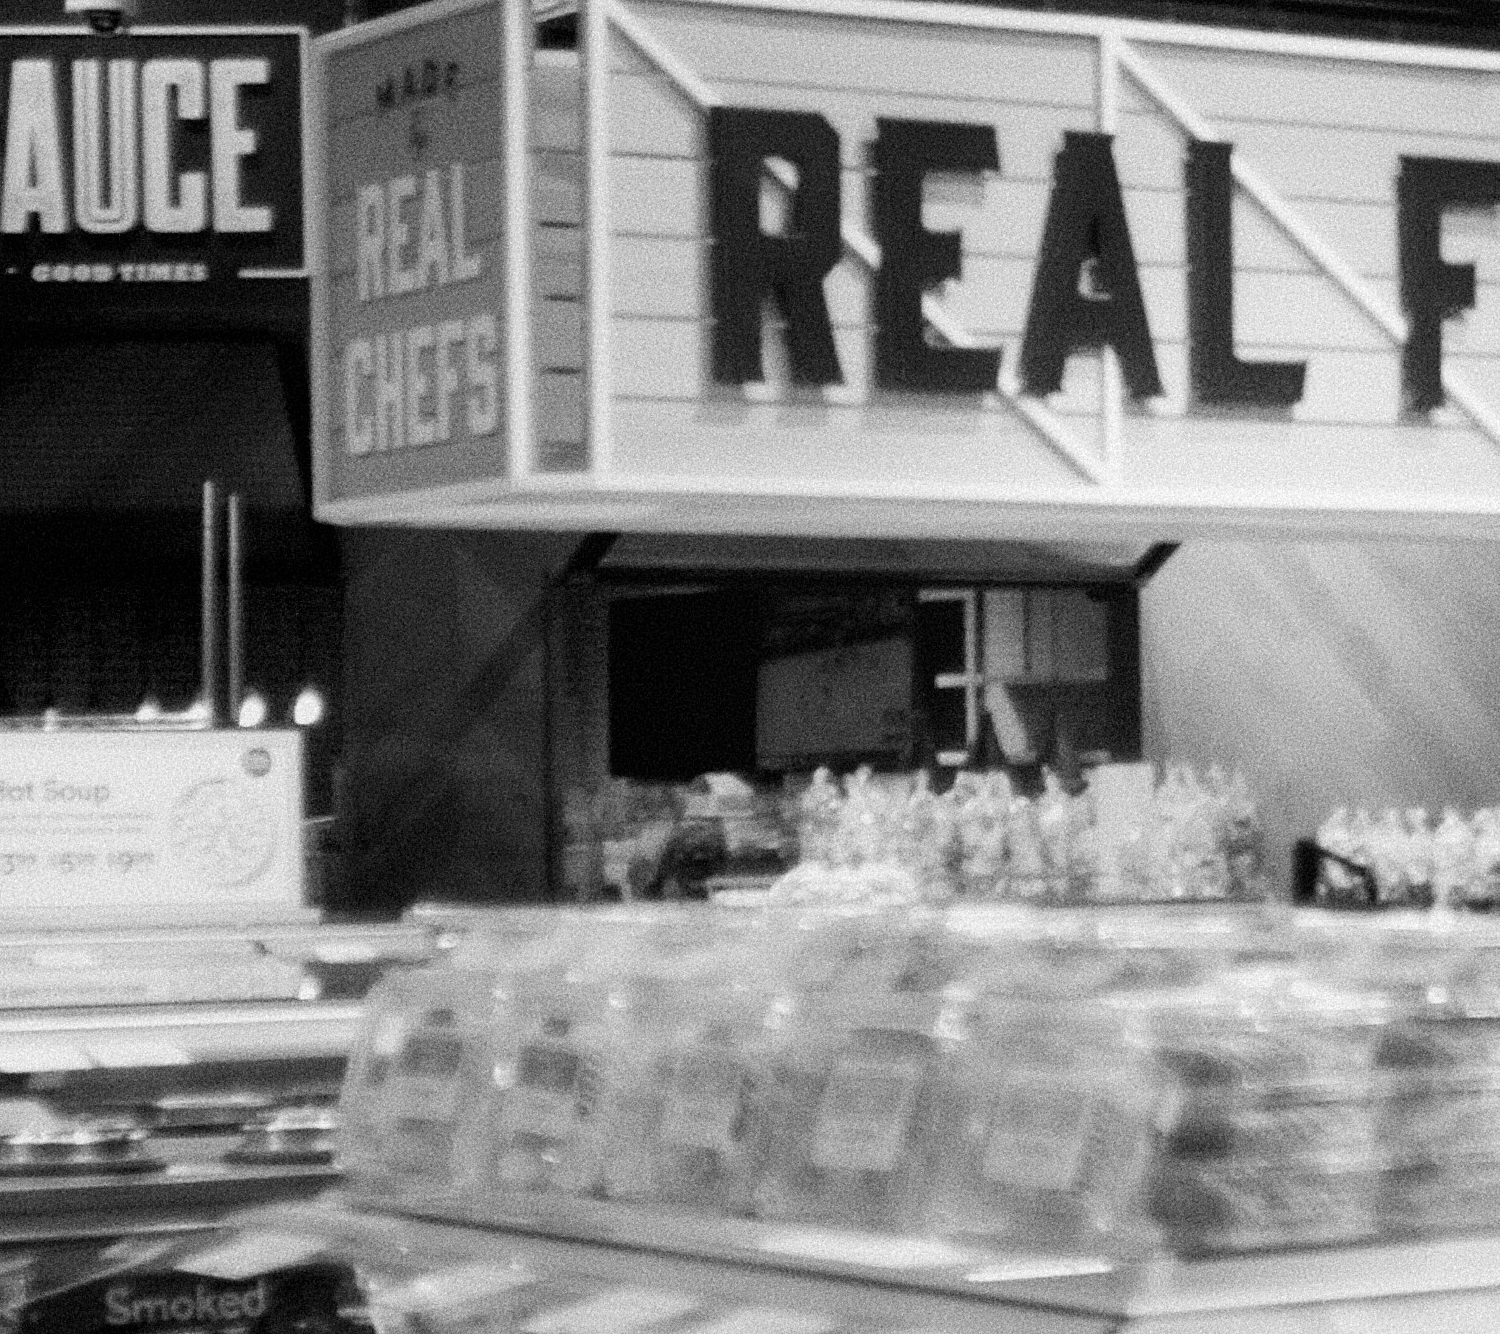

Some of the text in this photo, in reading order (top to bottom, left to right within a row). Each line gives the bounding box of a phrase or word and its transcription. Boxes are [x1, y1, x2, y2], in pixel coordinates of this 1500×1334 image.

[31, 264, 113, 283] GOOD
[119, 264, 208, 282] TIMES
[357, 164, 481, 302] REAL
[704, 104, 1310, 409] REAL
[345, 313, 498, 456] CHEFS
[43, 779, 111, 806] Soup
[104, 1278, 268, 1326] Smoked
